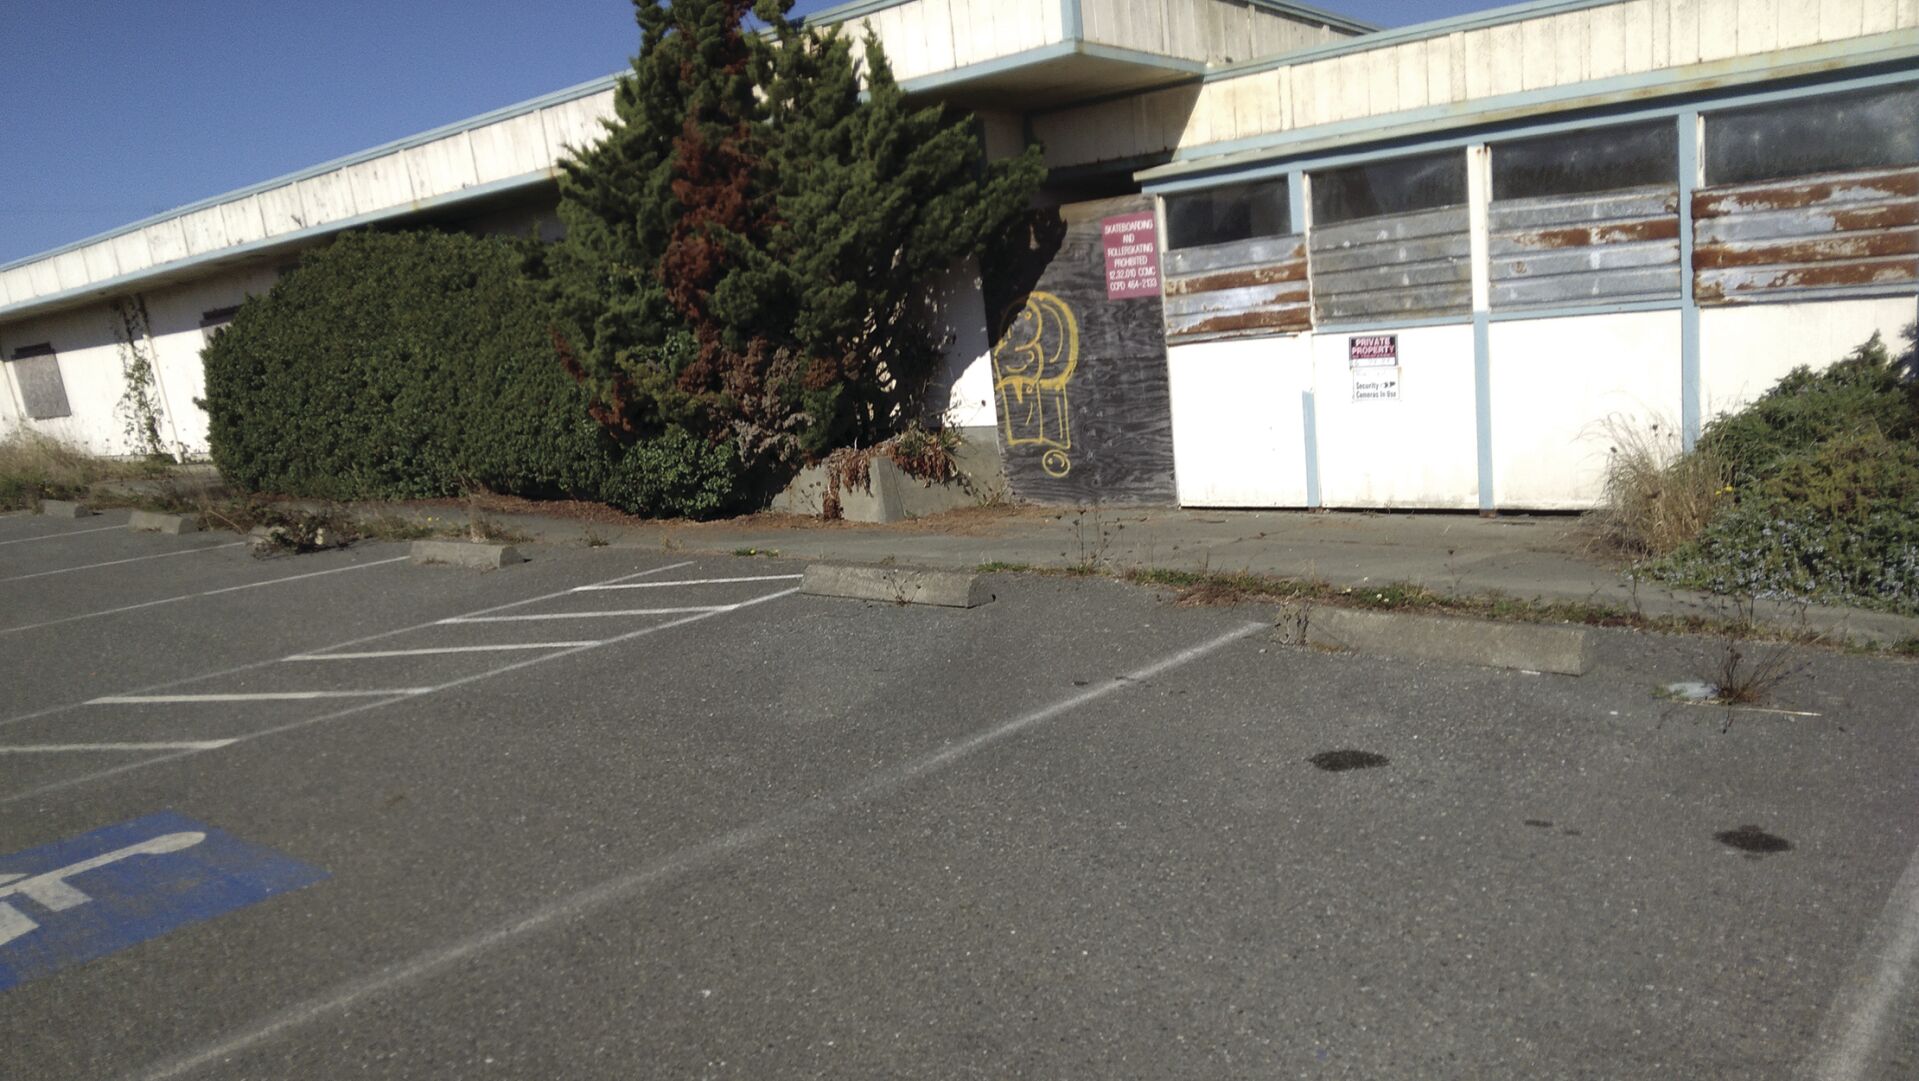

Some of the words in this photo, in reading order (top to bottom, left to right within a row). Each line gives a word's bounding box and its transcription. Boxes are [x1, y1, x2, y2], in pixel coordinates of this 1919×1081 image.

[1104, 219, 1153, 234] SKATEBOARDING
[1123, 233, 1134, 244] AND
[1107, 243, 1153, 257] ROLLERSKATING
[1114, 255, 1147, 269] PROHIBITED
[1355, 337, 1390, 347] PRIVATE
[1352, 345, 1395, 355] PROPERTY
[1356, 381, 1379, 390] Security
[1356, 391, 1379, 399] Cameras
